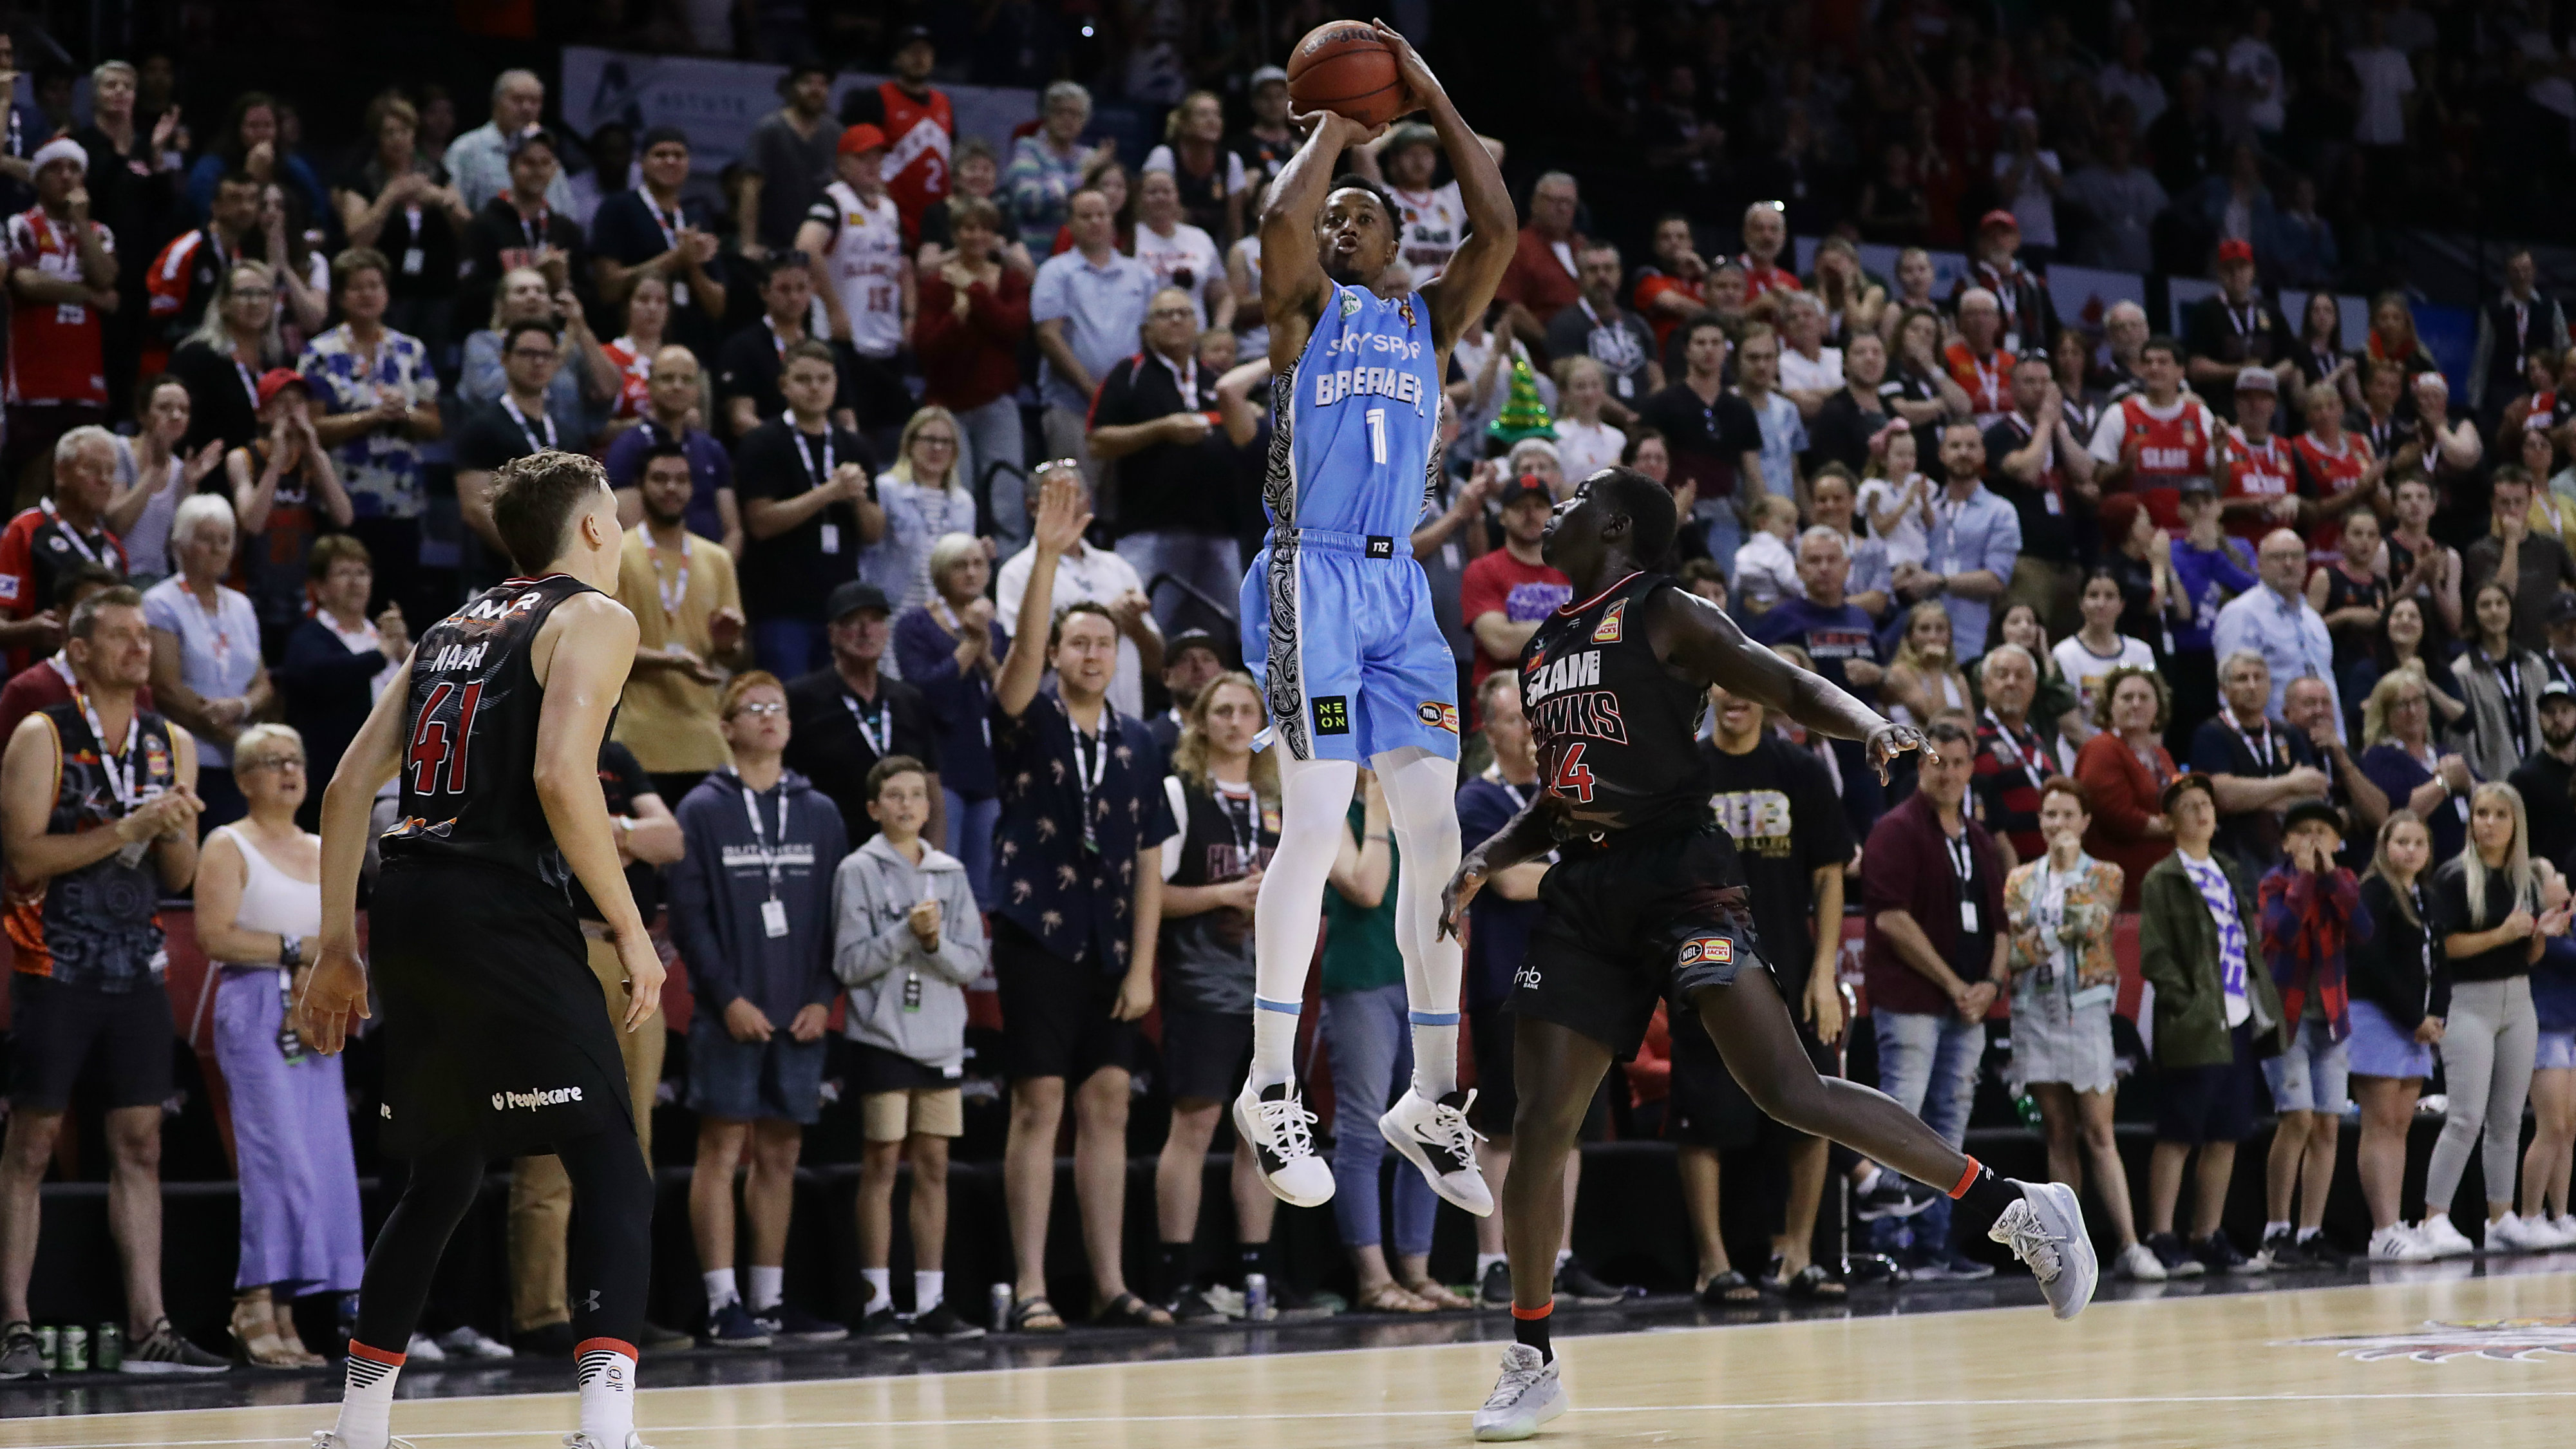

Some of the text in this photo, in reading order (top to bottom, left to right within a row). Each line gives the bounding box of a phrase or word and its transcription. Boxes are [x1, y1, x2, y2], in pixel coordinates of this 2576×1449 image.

[1366, 408, 1387, 464] 1
[1372, 542, 1390, 553] nz
[1526, 650, 1600, 707] SLAM
[1423, 707, 1437, 720] NBL
[408, 678, 484, 796] 41
[1683, 945, 1697, 961] NBL
[506, 1086, 582, 1112] Peoplecare
